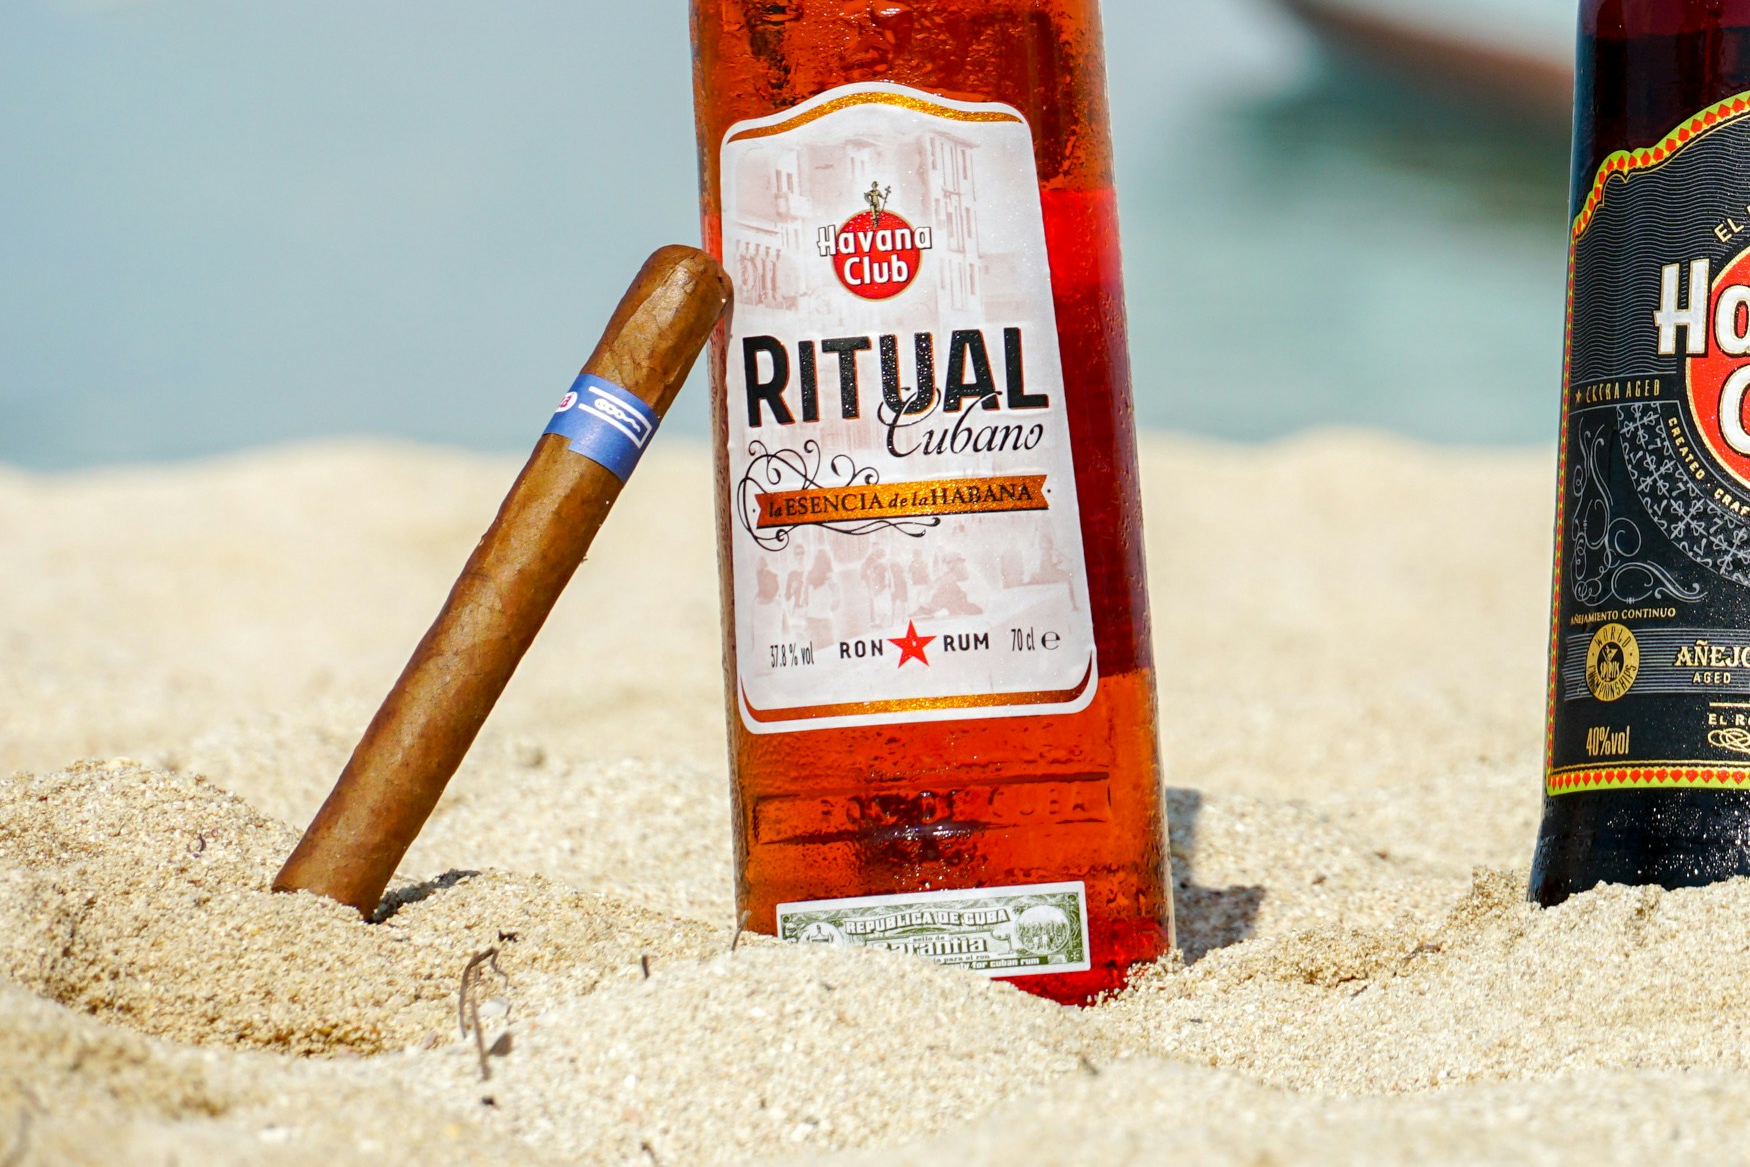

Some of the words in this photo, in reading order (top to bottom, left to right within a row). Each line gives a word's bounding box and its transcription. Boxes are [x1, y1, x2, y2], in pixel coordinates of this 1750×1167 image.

[816, 224, 932, 257] Havana
[1714, 218, 1745, 243] EL
[843, 253, 909, 286] Club
[742, 326, 1050, 429] RITUAL
[1626, 378, 1660, 398] AGED
[876, 386, 1044, 459] Cubano
[1668, 417, 1706, 481] CREATED
[785, 492, 884, 517] ESENCIA
[930, 484, 1034, 506] HABANA
[1621, 607, 1677, 619] CONTINUO
[839, 638, 884, 660] RON
[943, 632, 990, 653] RUM
[1010, 628, 1024, 652] 70
[1026, 626, 1035, 651] cl
[1593, 625, 1632, 649] WORLD
[770, 644, 787, 668] 37.8
[800, 640, 815, 666] vol
[1692, 671, 1732, 684] AGED
[1707, 713, 1728, 726] EL
[844, 911, 937, 934] REPUBLICA
[938, 911, 962, 925] DE
[964, 909, 1011, 925] CUBA
[971, 960, 988, 969] for
[990, 959, 1018, 968] cuban
[1020, 957, 1039, 966] rum
